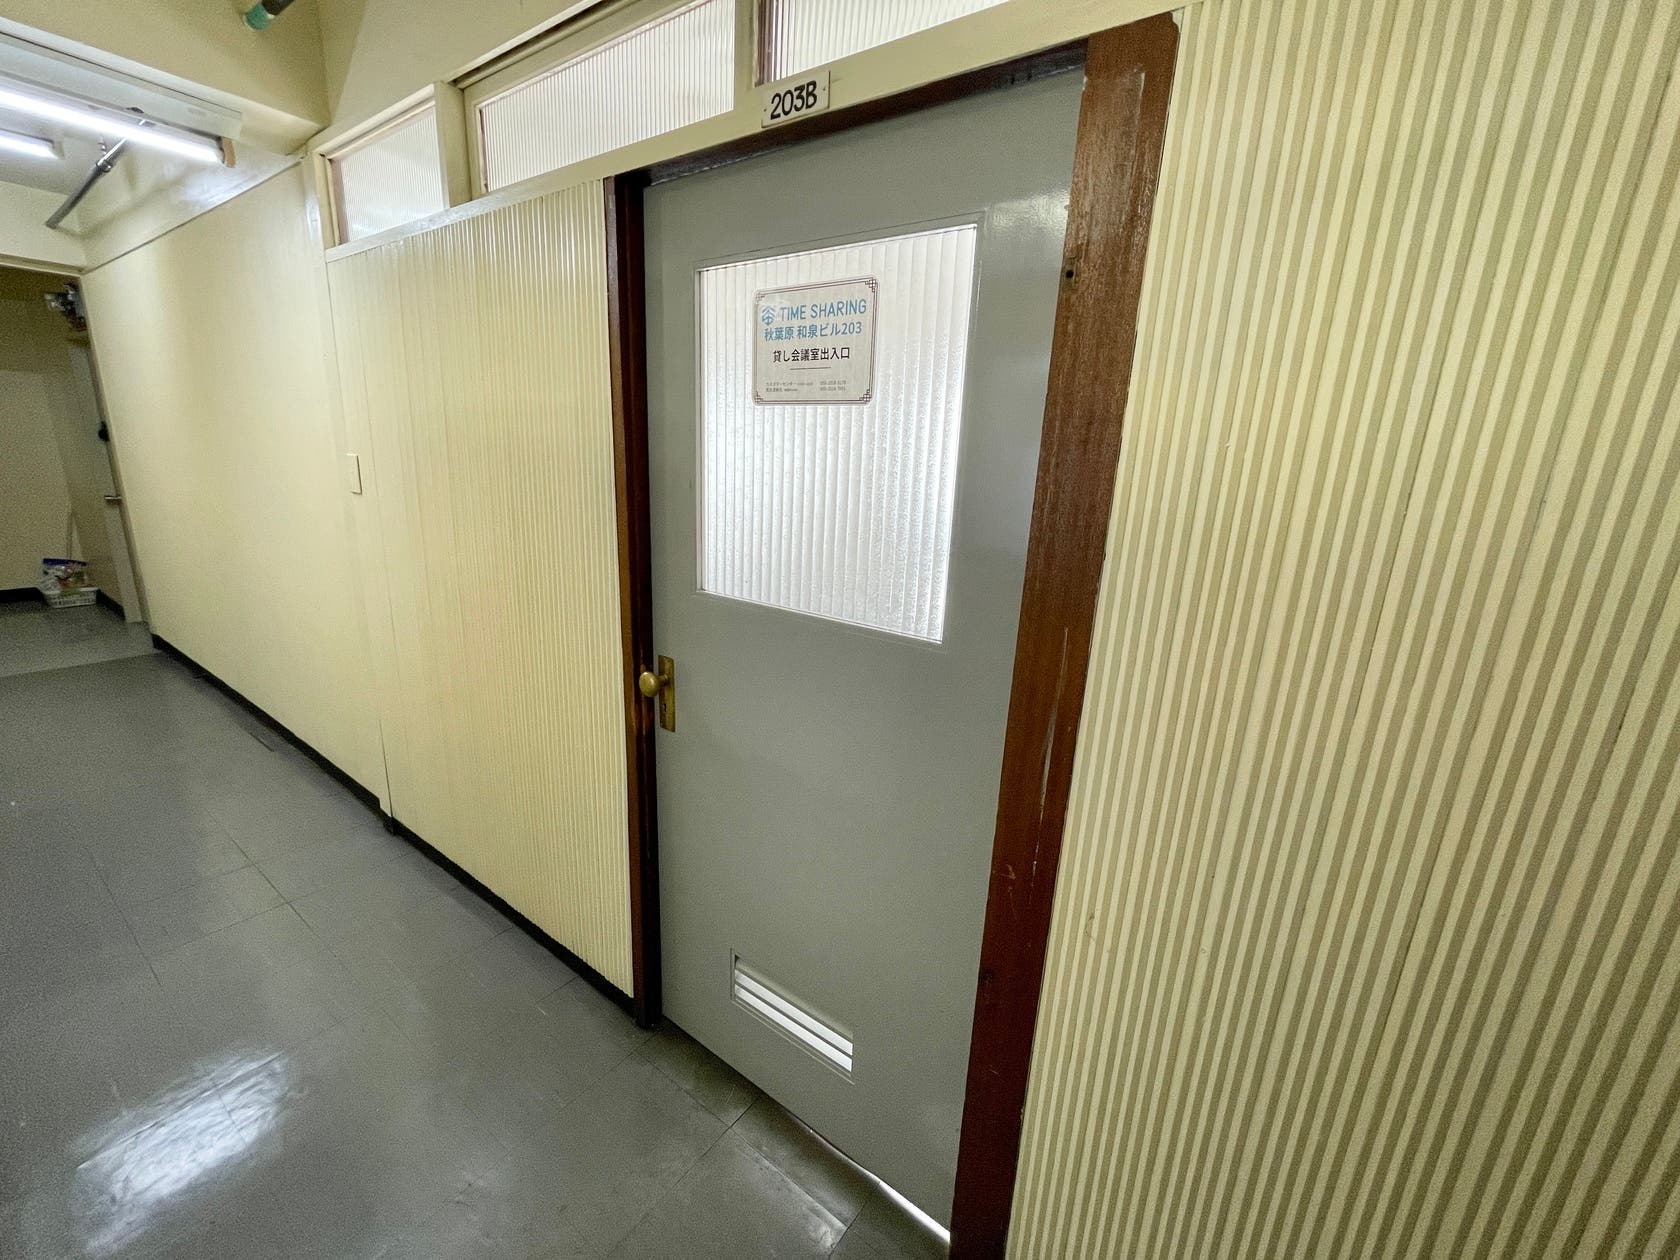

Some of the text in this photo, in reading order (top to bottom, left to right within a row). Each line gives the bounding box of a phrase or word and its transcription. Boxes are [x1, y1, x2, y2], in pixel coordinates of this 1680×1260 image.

[771, 80, 817, 120] 203B
[780, 299, 867, 321] TIME SHARING
[764, 321, 862, 342] 秋葉原 和泉ビル203
[773, 347, 850, 363] 貸し会議室出入口
